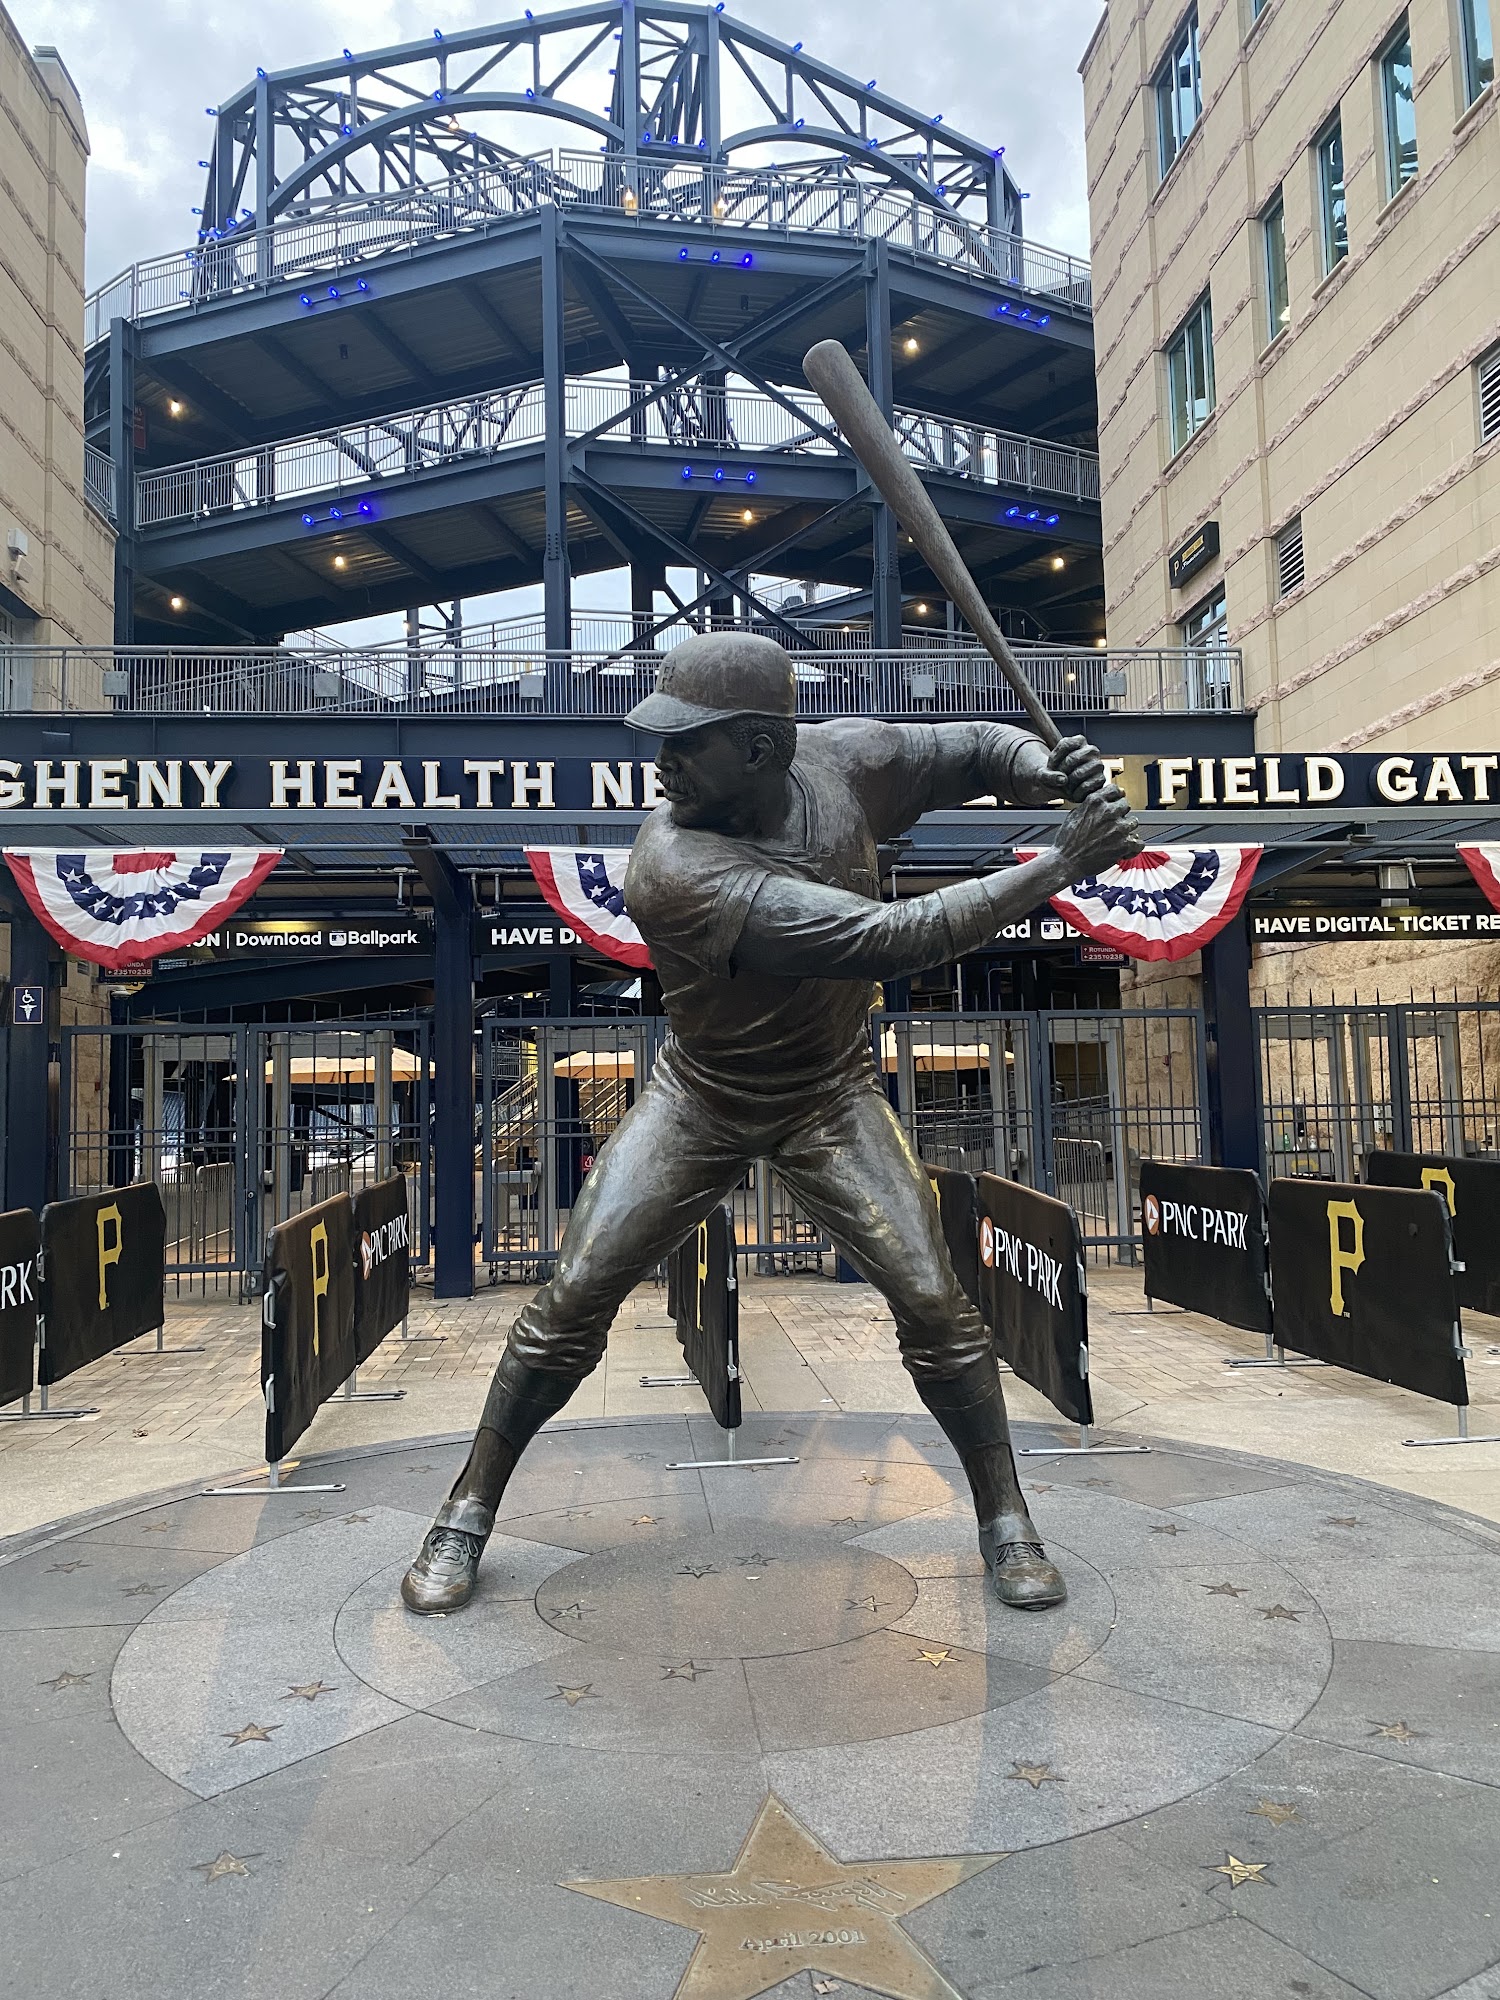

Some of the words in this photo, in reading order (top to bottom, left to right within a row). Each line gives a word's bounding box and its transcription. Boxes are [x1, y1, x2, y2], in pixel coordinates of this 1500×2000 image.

[269, 760, 554, 809] HEALTH
[1157, 757, 1345, 804] FIELD
[236, 931, 322, 947] Download
[491, 928, 554, 945] HAVE
[1255, 917, 1311, 933] HAVE
[1315, 916, 1396, 933] DIGITAL
[1399, 915, 1471, 931] TICKET
[370, 1229, 387, 1270] PNC
[388, 1213, 409, 1256] PARK
[1161, 1200, 1199, 1240] PNC
[1201, 1206, 1249, 1250] PARK
[96, 1202, 122, 1310] P
[994, 1226, 1022, 1282] PNC
[1025, 1242, 1063, 1311] PARK
[1327, 1199, 1366, 1316] P
[0, 1260, 33, 1310] RK
[738, 1931, 803, 1952] April
[808, 1928, 867, 1945] 2001
